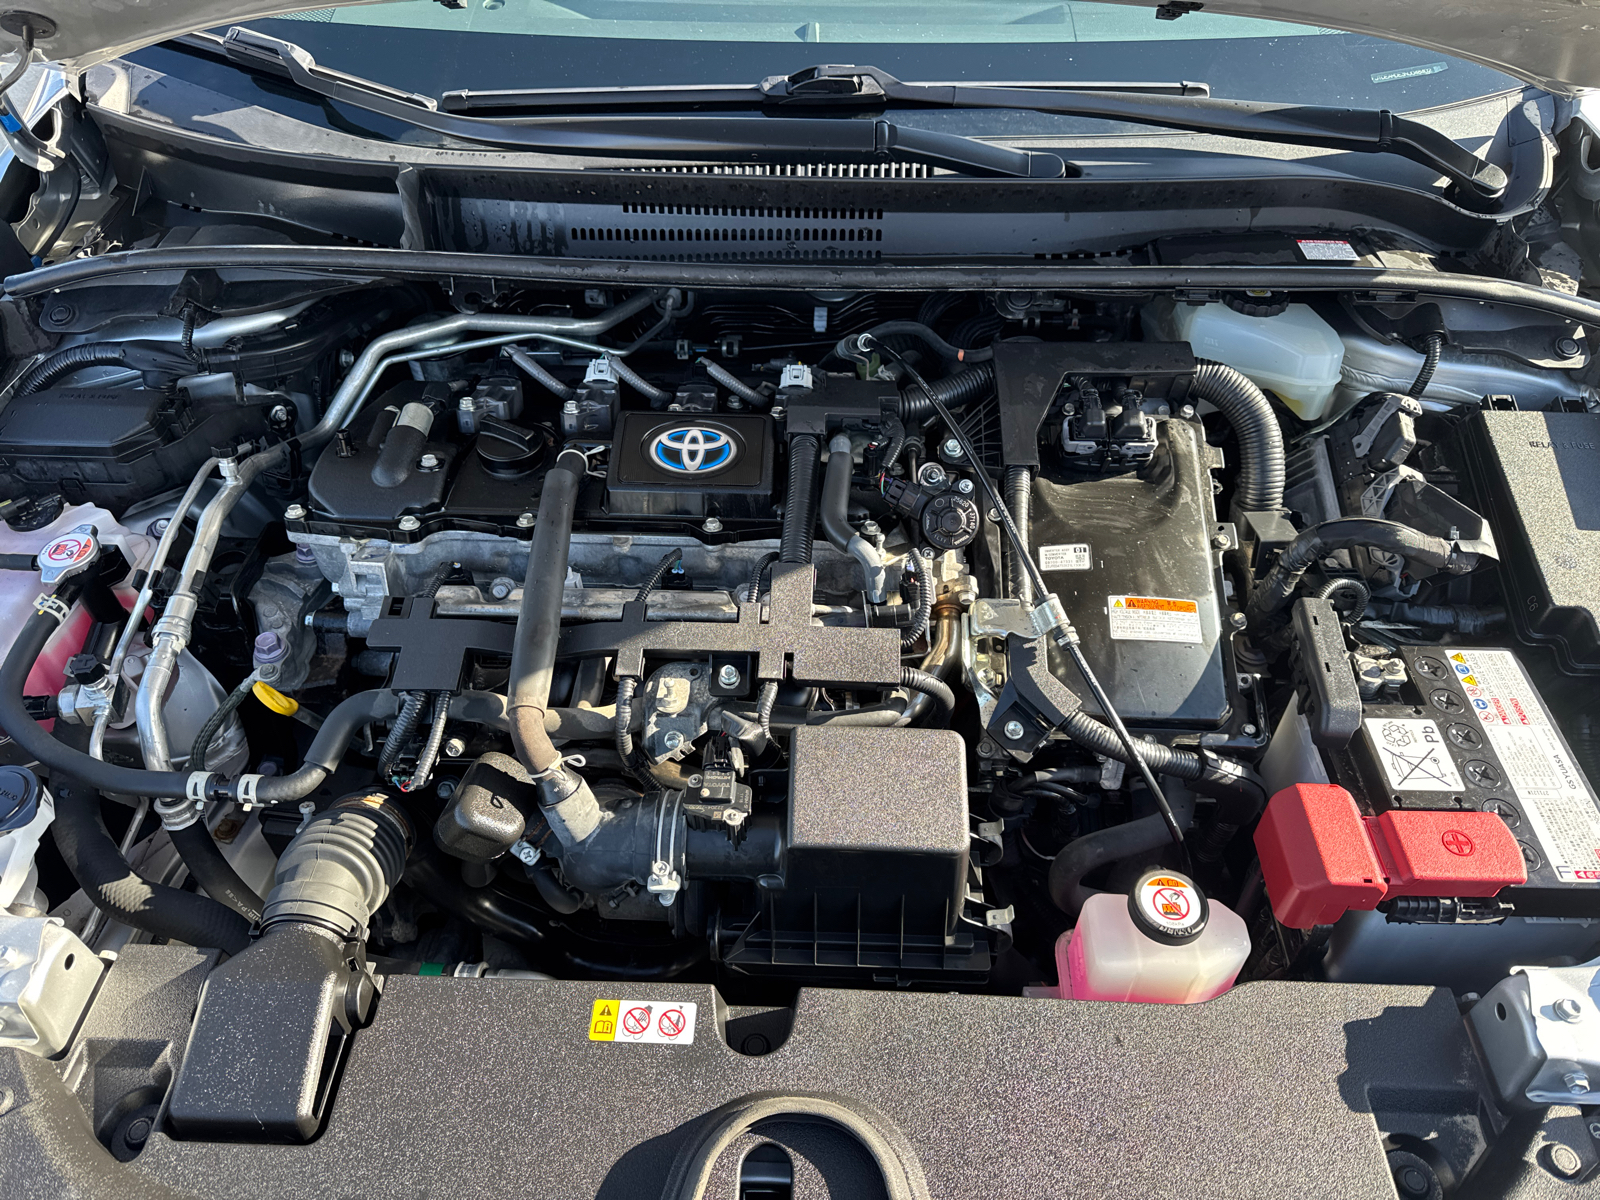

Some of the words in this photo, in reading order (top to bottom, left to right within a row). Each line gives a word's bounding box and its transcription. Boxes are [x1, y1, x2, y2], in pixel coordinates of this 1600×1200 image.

[1529, 440, 1558, 449] RELAY
[1571, 441, 1595, 450] FUSE
[1466, 653, 1482, 669] GASES
[1422, 726, 1439, 743] Pb
[1551, 754, 1572, 779] YUASA
[1565, 779, 1577, 789] GS
[1159, 925, 1193, 936] DENSO
